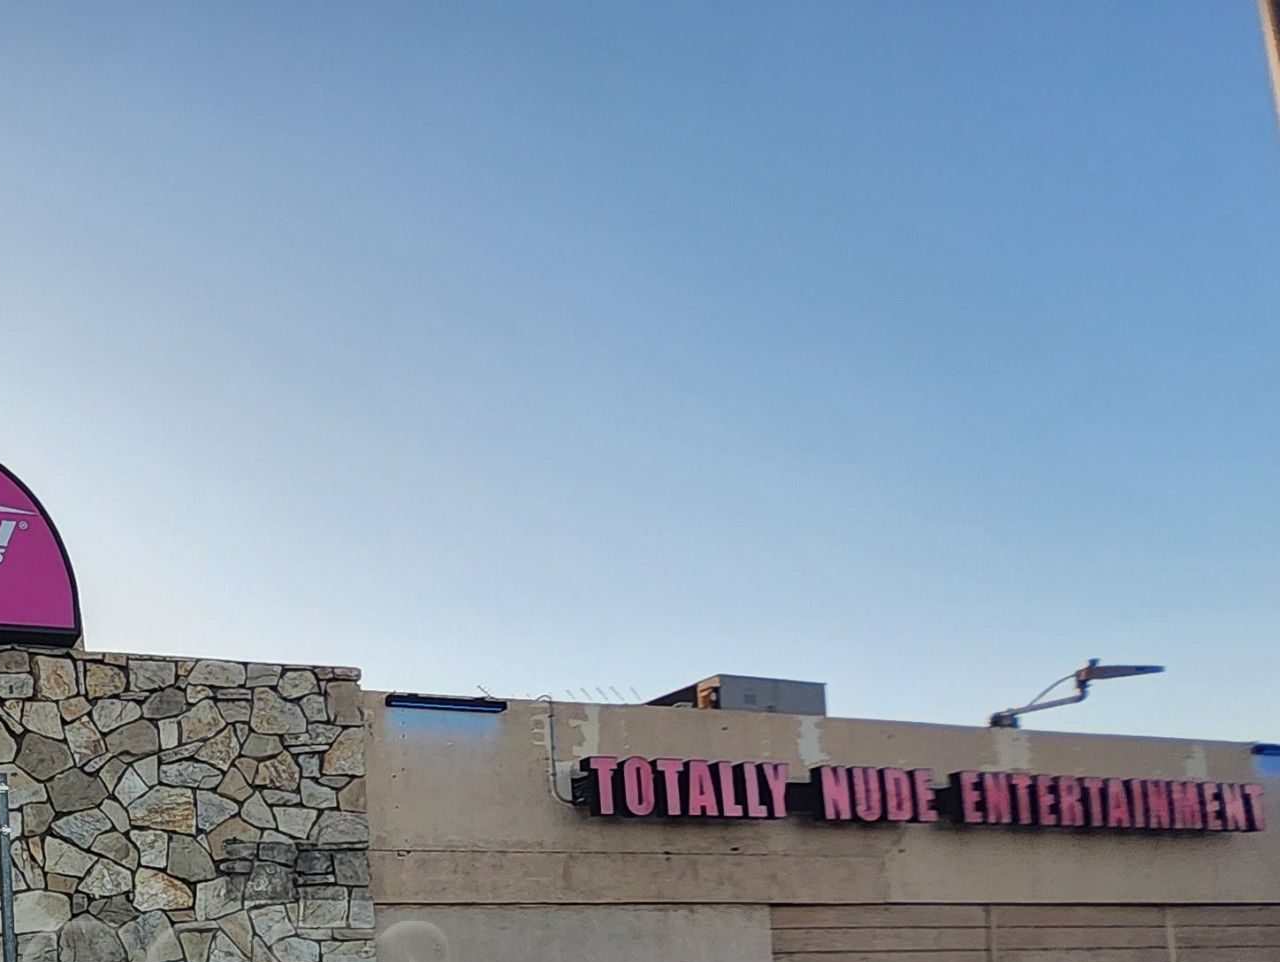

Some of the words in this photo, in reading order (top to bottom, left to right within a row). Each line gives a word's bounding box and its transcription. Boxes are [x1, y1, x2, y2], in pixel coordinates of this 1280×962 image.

[589, 755, 789, 818] TOTALLY
[819, 765, 939, 823] NUDE
[959, 770, 1267, 832] ENTERTAINMENT
